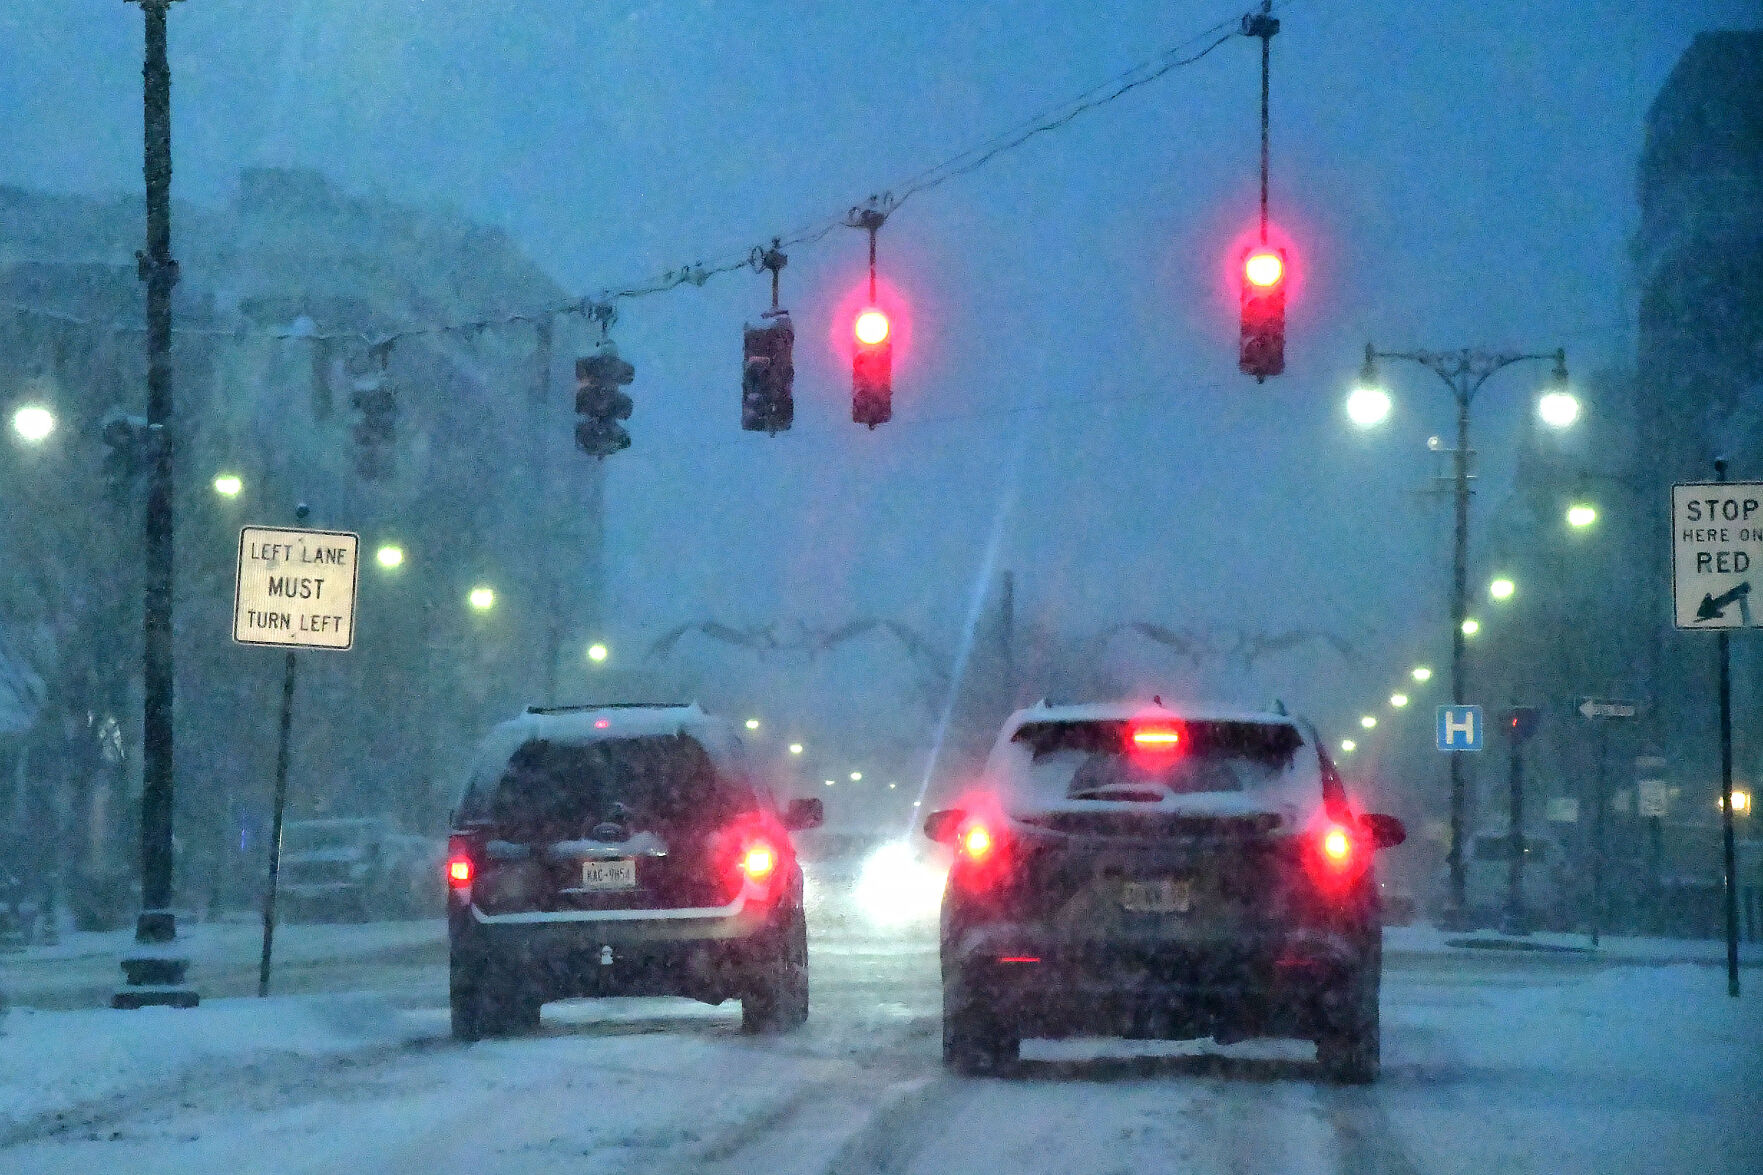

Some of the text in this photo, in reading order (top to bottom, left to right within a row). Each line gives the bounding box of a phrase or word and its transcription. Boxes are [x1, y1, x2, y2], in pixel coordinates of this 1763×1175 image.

[1687, 499, 1759, 521] STOP
[1683, 528, 1763, 542] HERE ON
[251, 542, 347, 565] LEFT LANE
[1697, 551, 1750, 573] RED
[268, 576, 324, 599] MUST
[247, 608, 342, 632] TURN LEFT
[1445, 711, 1474, 745] H
